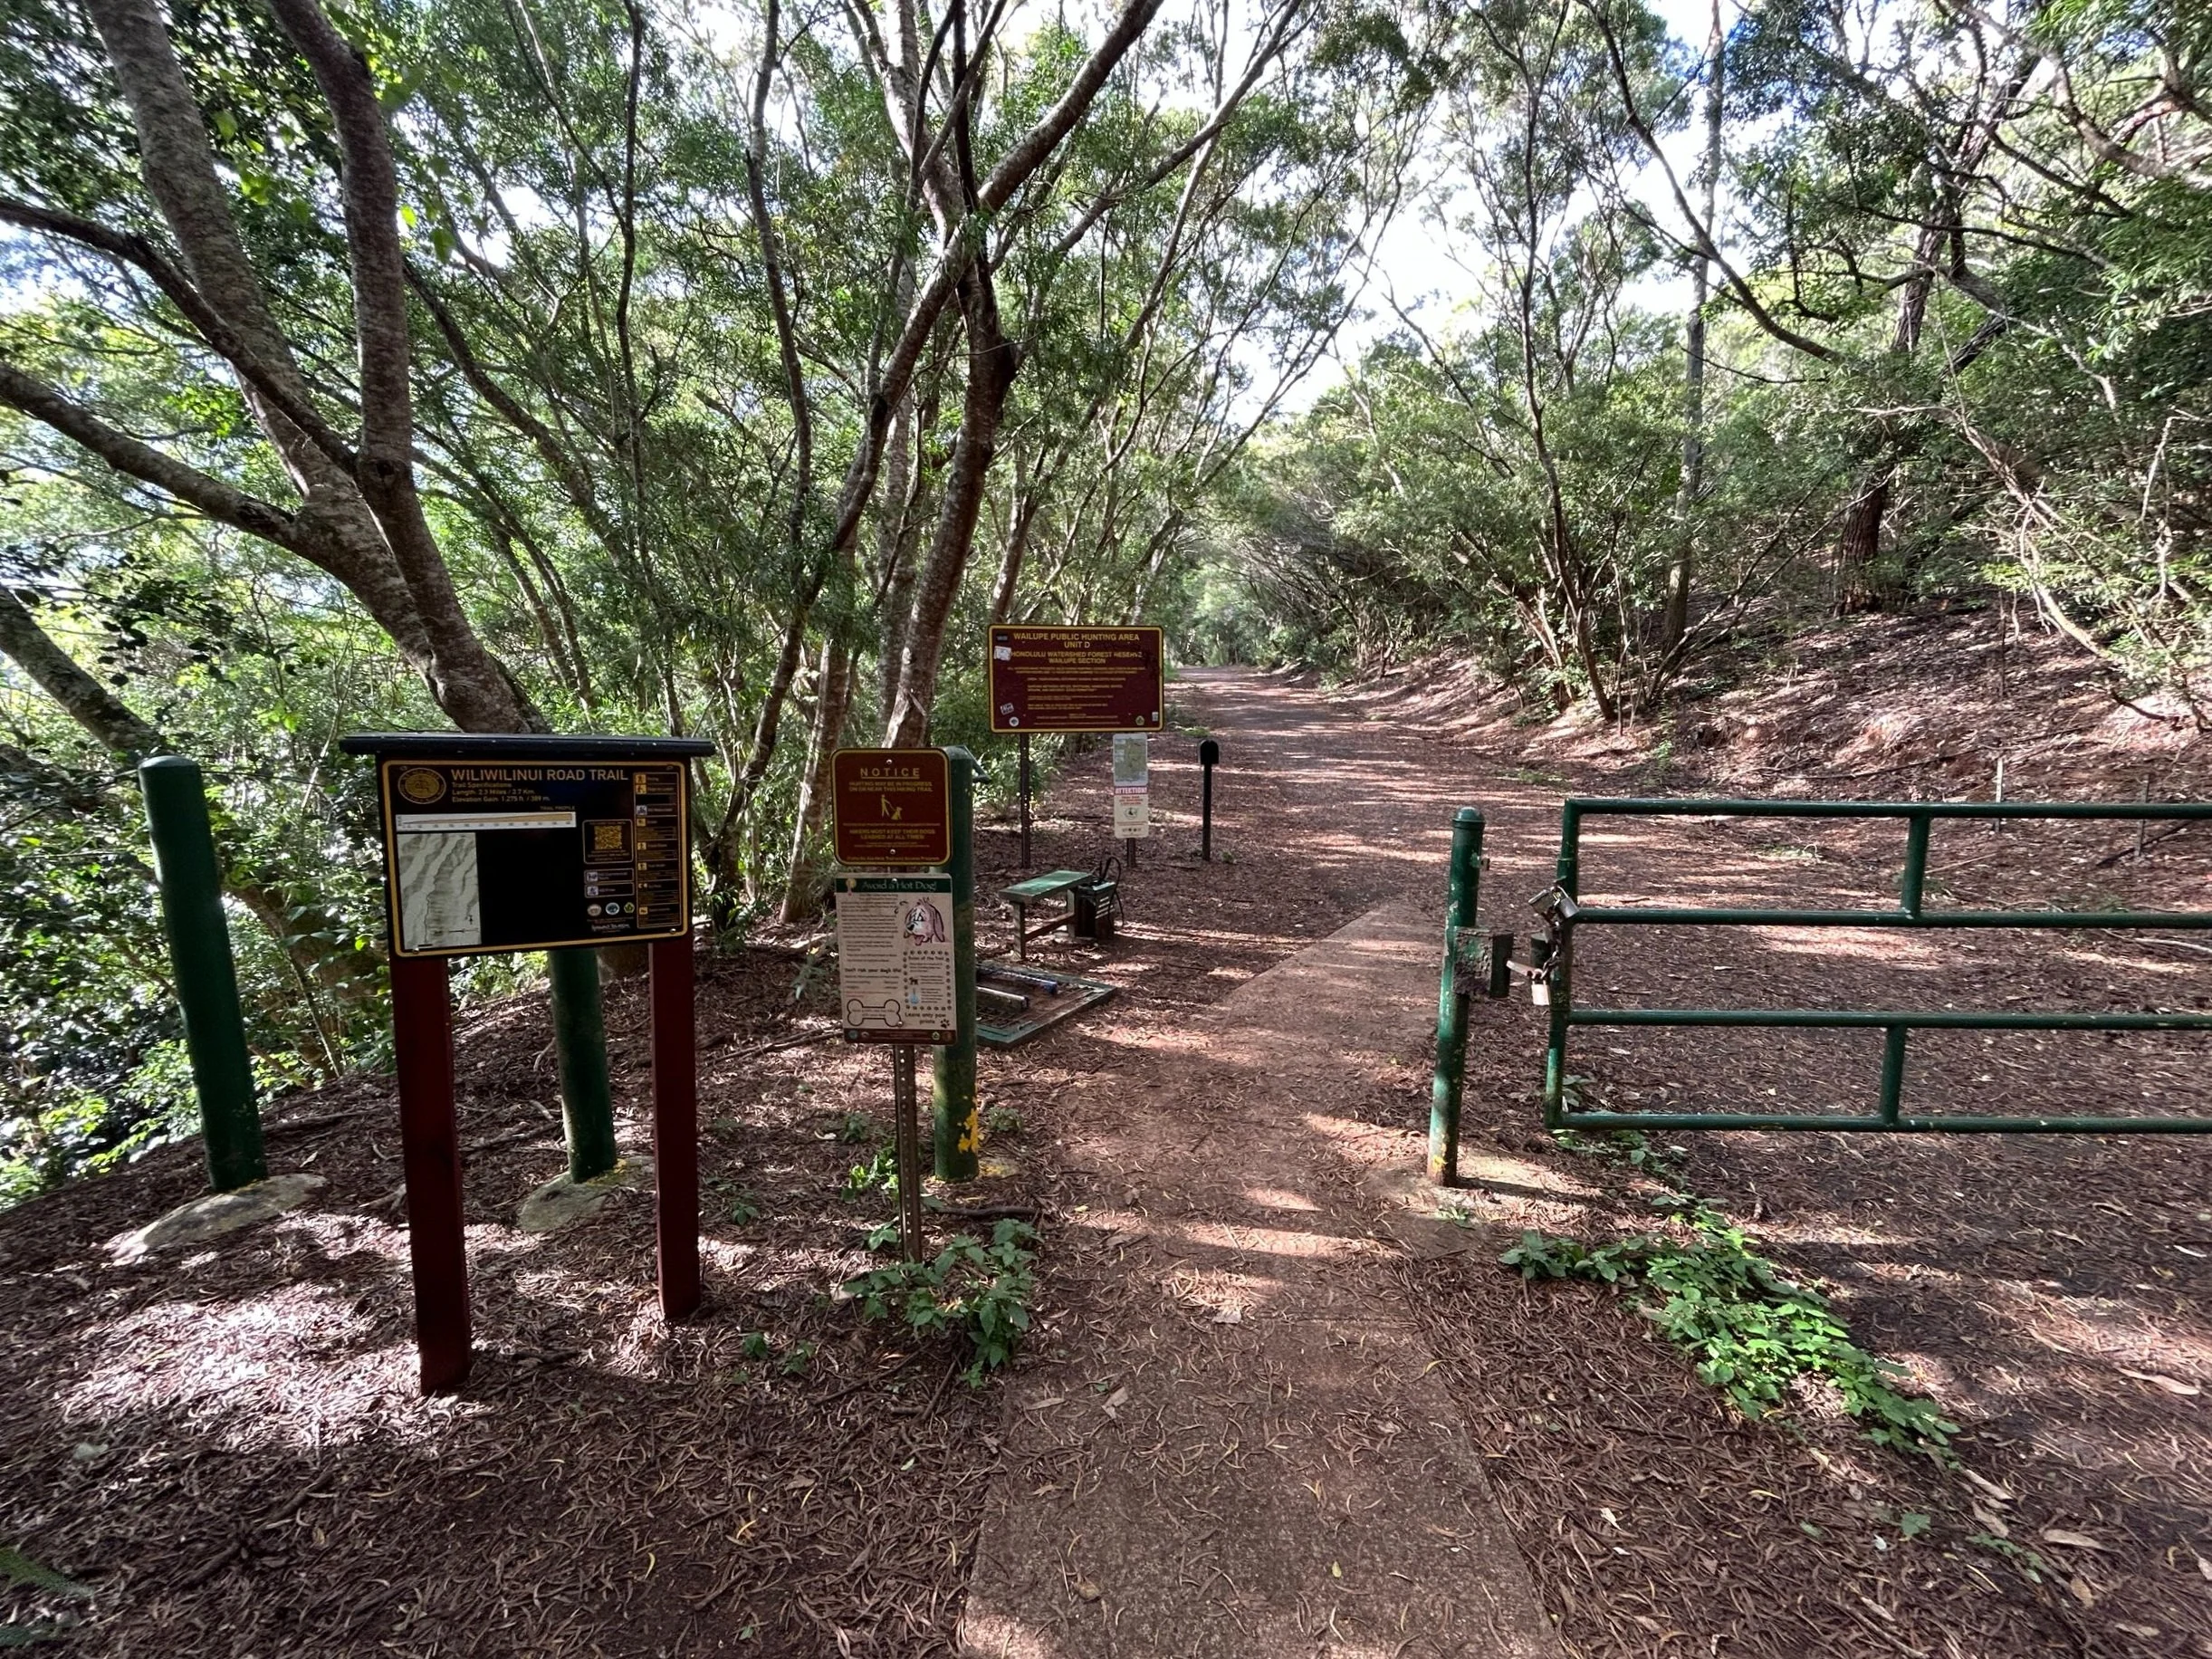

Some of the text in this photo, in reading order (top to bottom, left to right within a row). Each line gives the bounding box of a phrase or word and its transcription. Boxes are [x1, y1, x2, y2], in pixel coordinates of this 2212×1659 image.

[1081, 633, 1116, 641] HUNTING
[451, 769, 628, 781] WILIWILINUI ROAD TRAIL
[860, 768, 920, 777] NOTICE
[863, 879, 886, 889] Avoid
[896, 879, 914, 889] Hot
